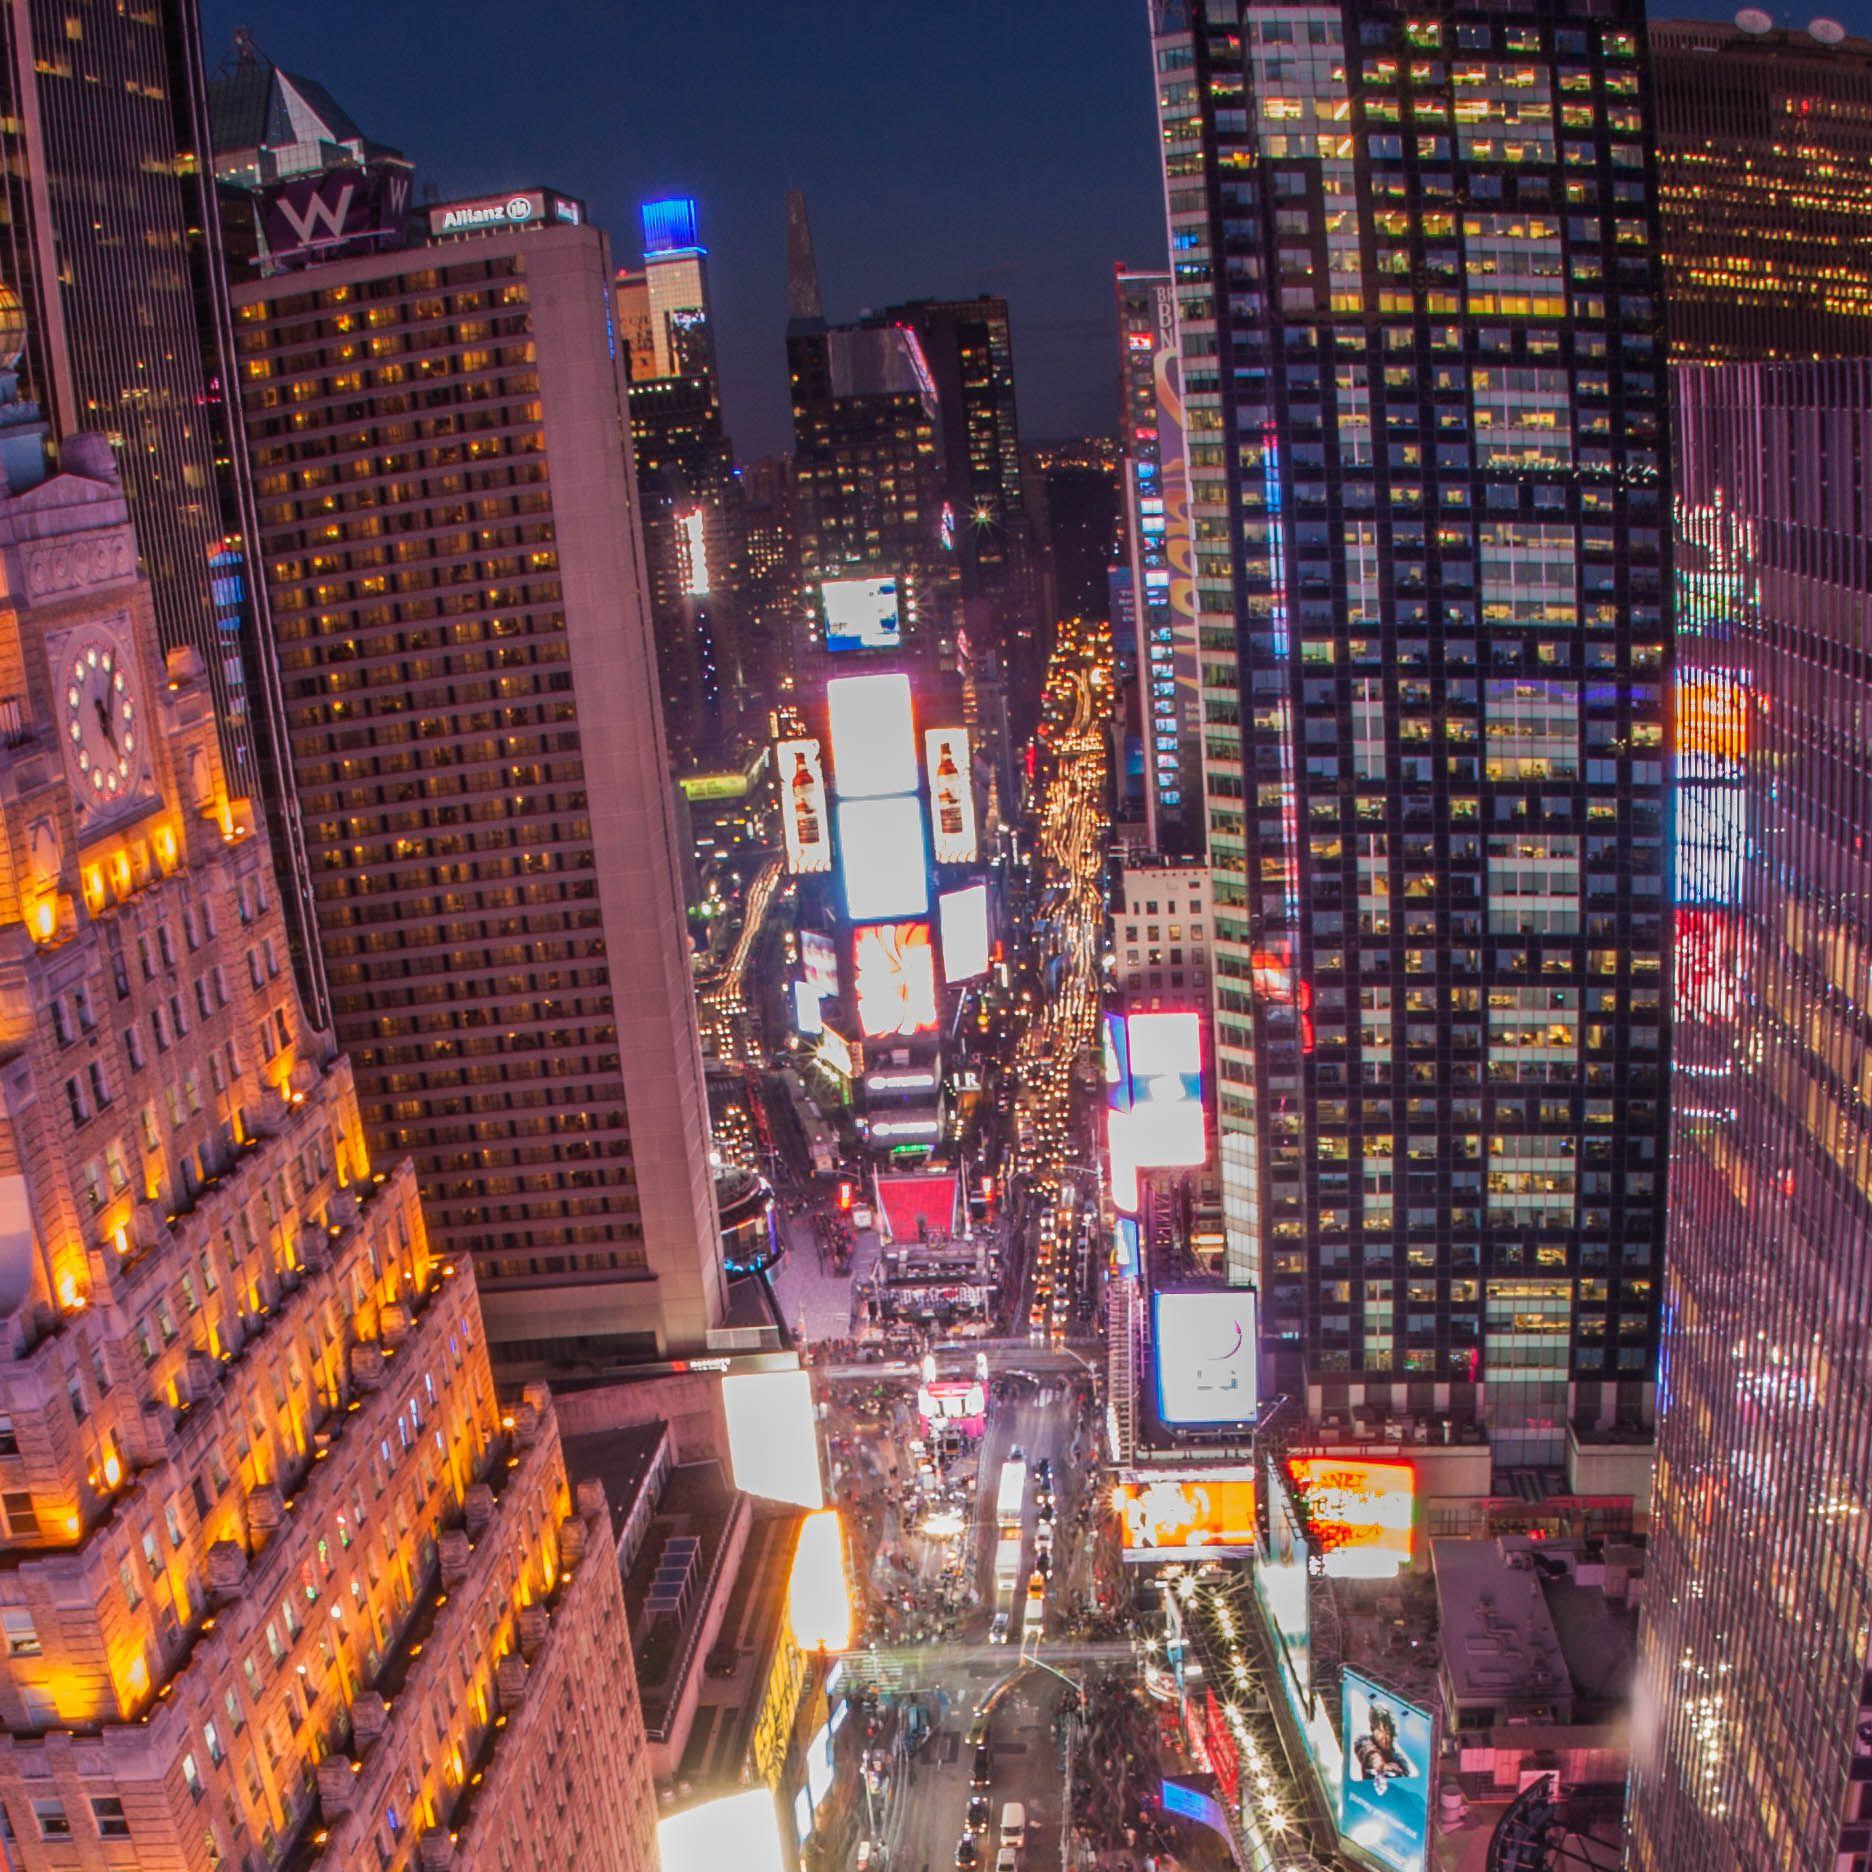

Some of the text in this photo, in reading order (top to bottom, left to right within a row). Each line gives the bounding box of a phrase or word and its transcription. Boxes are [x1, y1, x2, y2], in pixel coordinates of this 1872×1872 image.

[277, 184, 354, 246] W
[389, 176, 410, 215] W
[443, 206, 505, 229] Allianz
